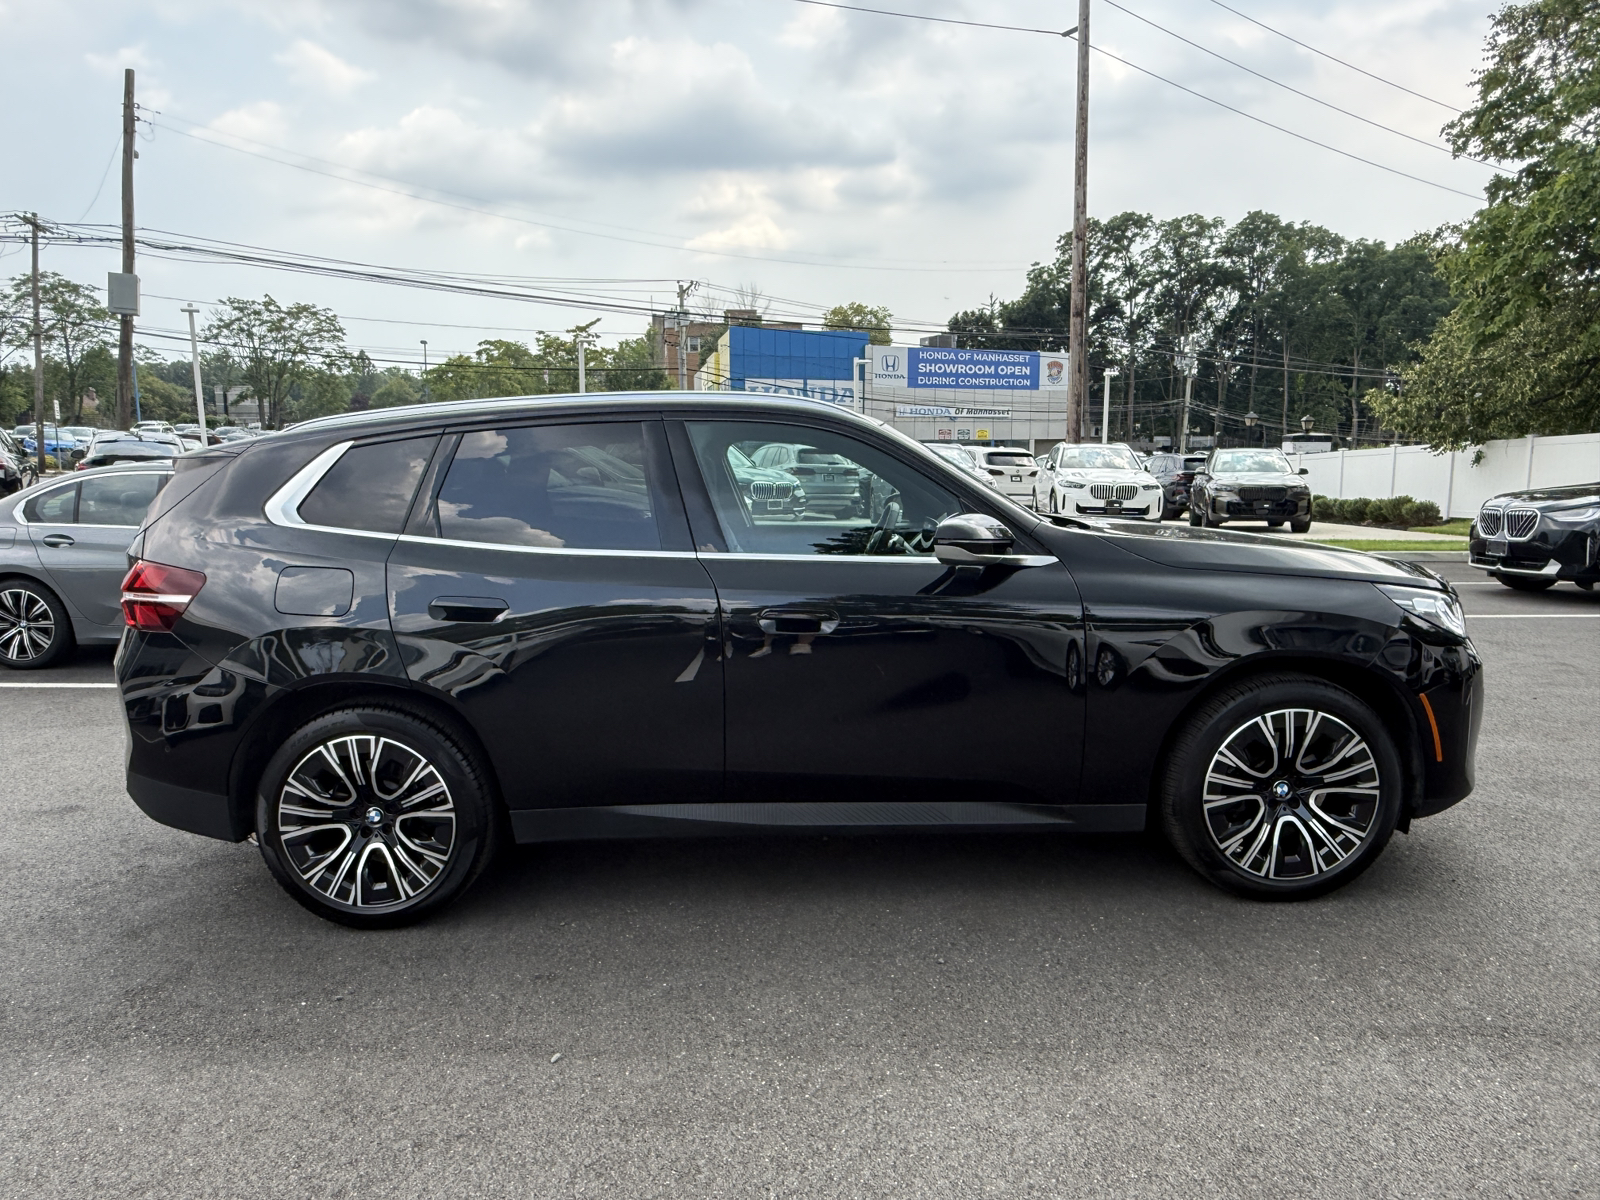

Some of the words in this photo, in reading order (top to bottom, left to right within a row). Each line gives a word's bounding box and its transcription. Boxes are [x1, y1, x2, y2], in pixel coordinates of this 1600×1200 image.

[919, 351, 956, 360] HONDA
[958, 352, 971, 361] OF
[973, 353, 1030, 363] MANHASSET
[918, 363, 995, 375] SHOWROOM
[997, 365, 1030, 375] OPEN
[917, 376, 956, 385] DURING
[958, 377, 1030, 386] CONSTRUCTION
